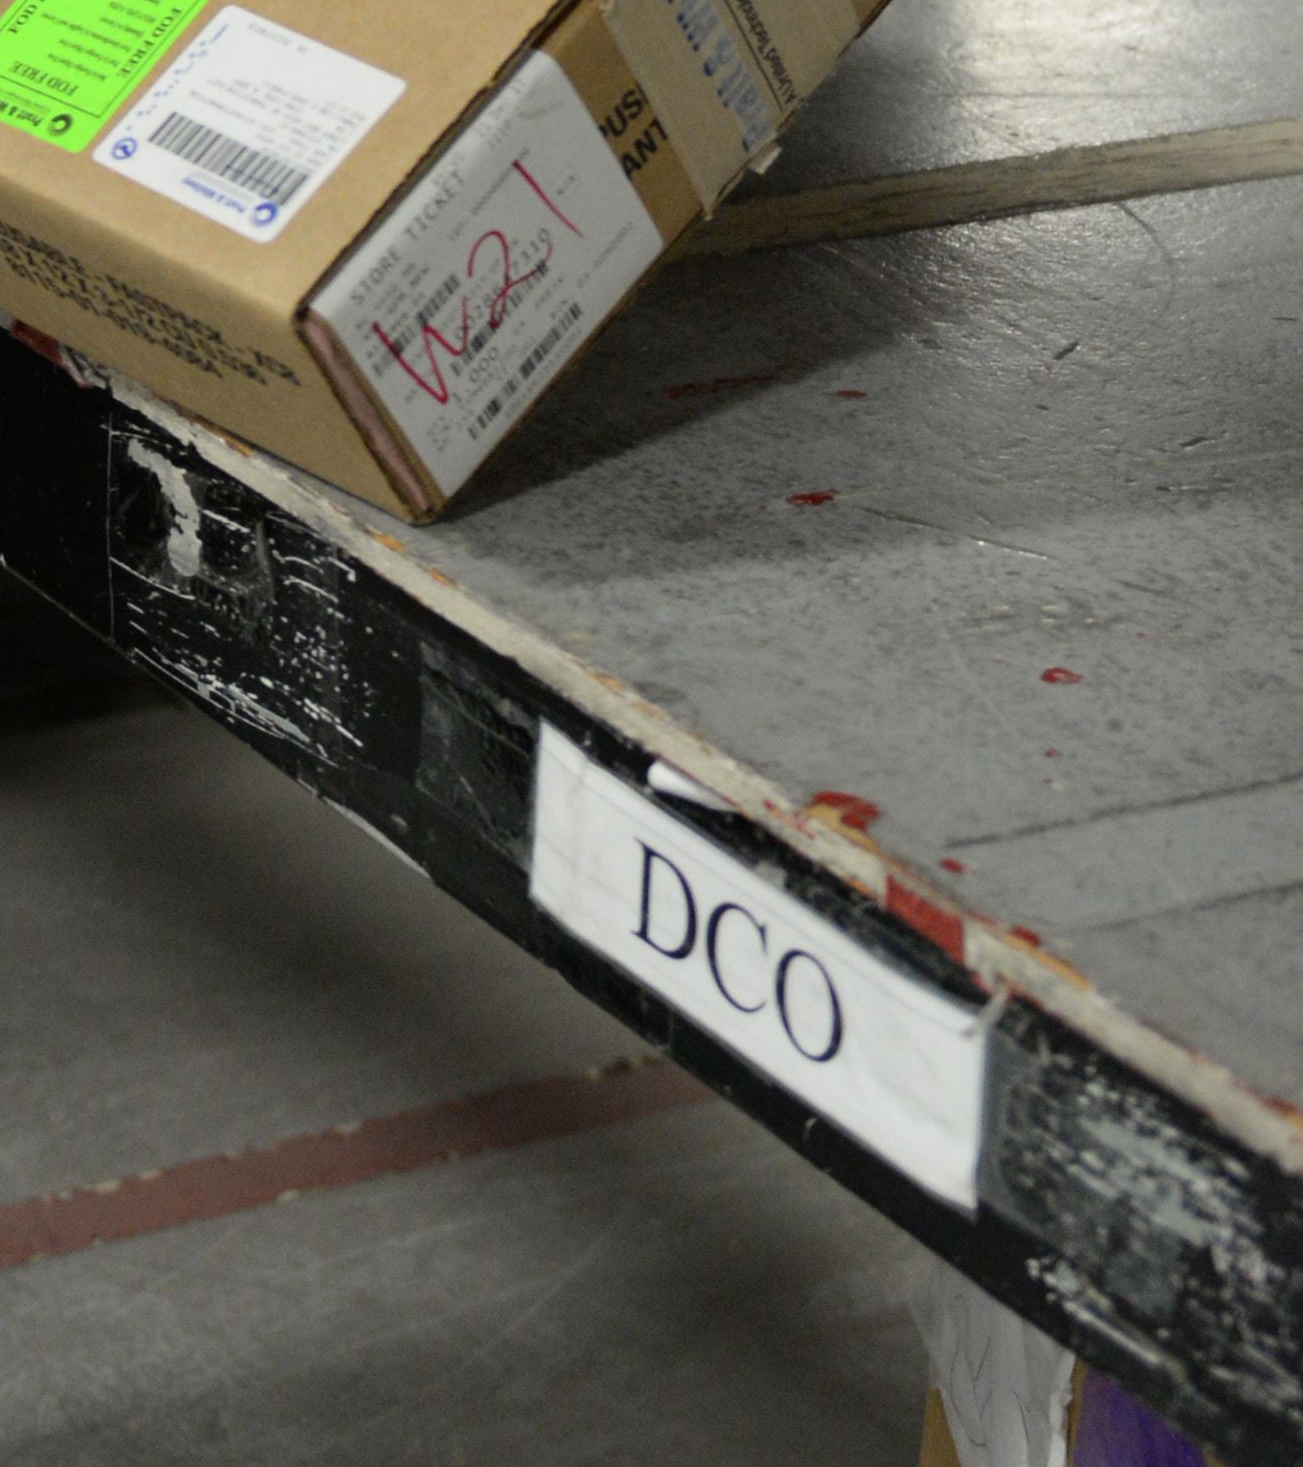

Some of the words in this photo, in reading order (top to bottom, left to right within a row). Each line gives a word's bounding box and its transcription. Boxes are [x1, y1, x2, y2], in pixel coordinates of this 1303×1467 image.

[6, 2, 40, 34] FOD
[149, 6, 182, 38] FOD
[7, 58, 50, 86] FREE
[114, 37, 156, 80] FREE
[761, 43, 794, 100] United
[43, 73, 80, 98] FOD
[12, 107, 44, 129] Pratt
[347, 242, 403, 309] STORE
[402, 166, 467, 245] TICKET
[632, 835, 844, 1064] DCO
